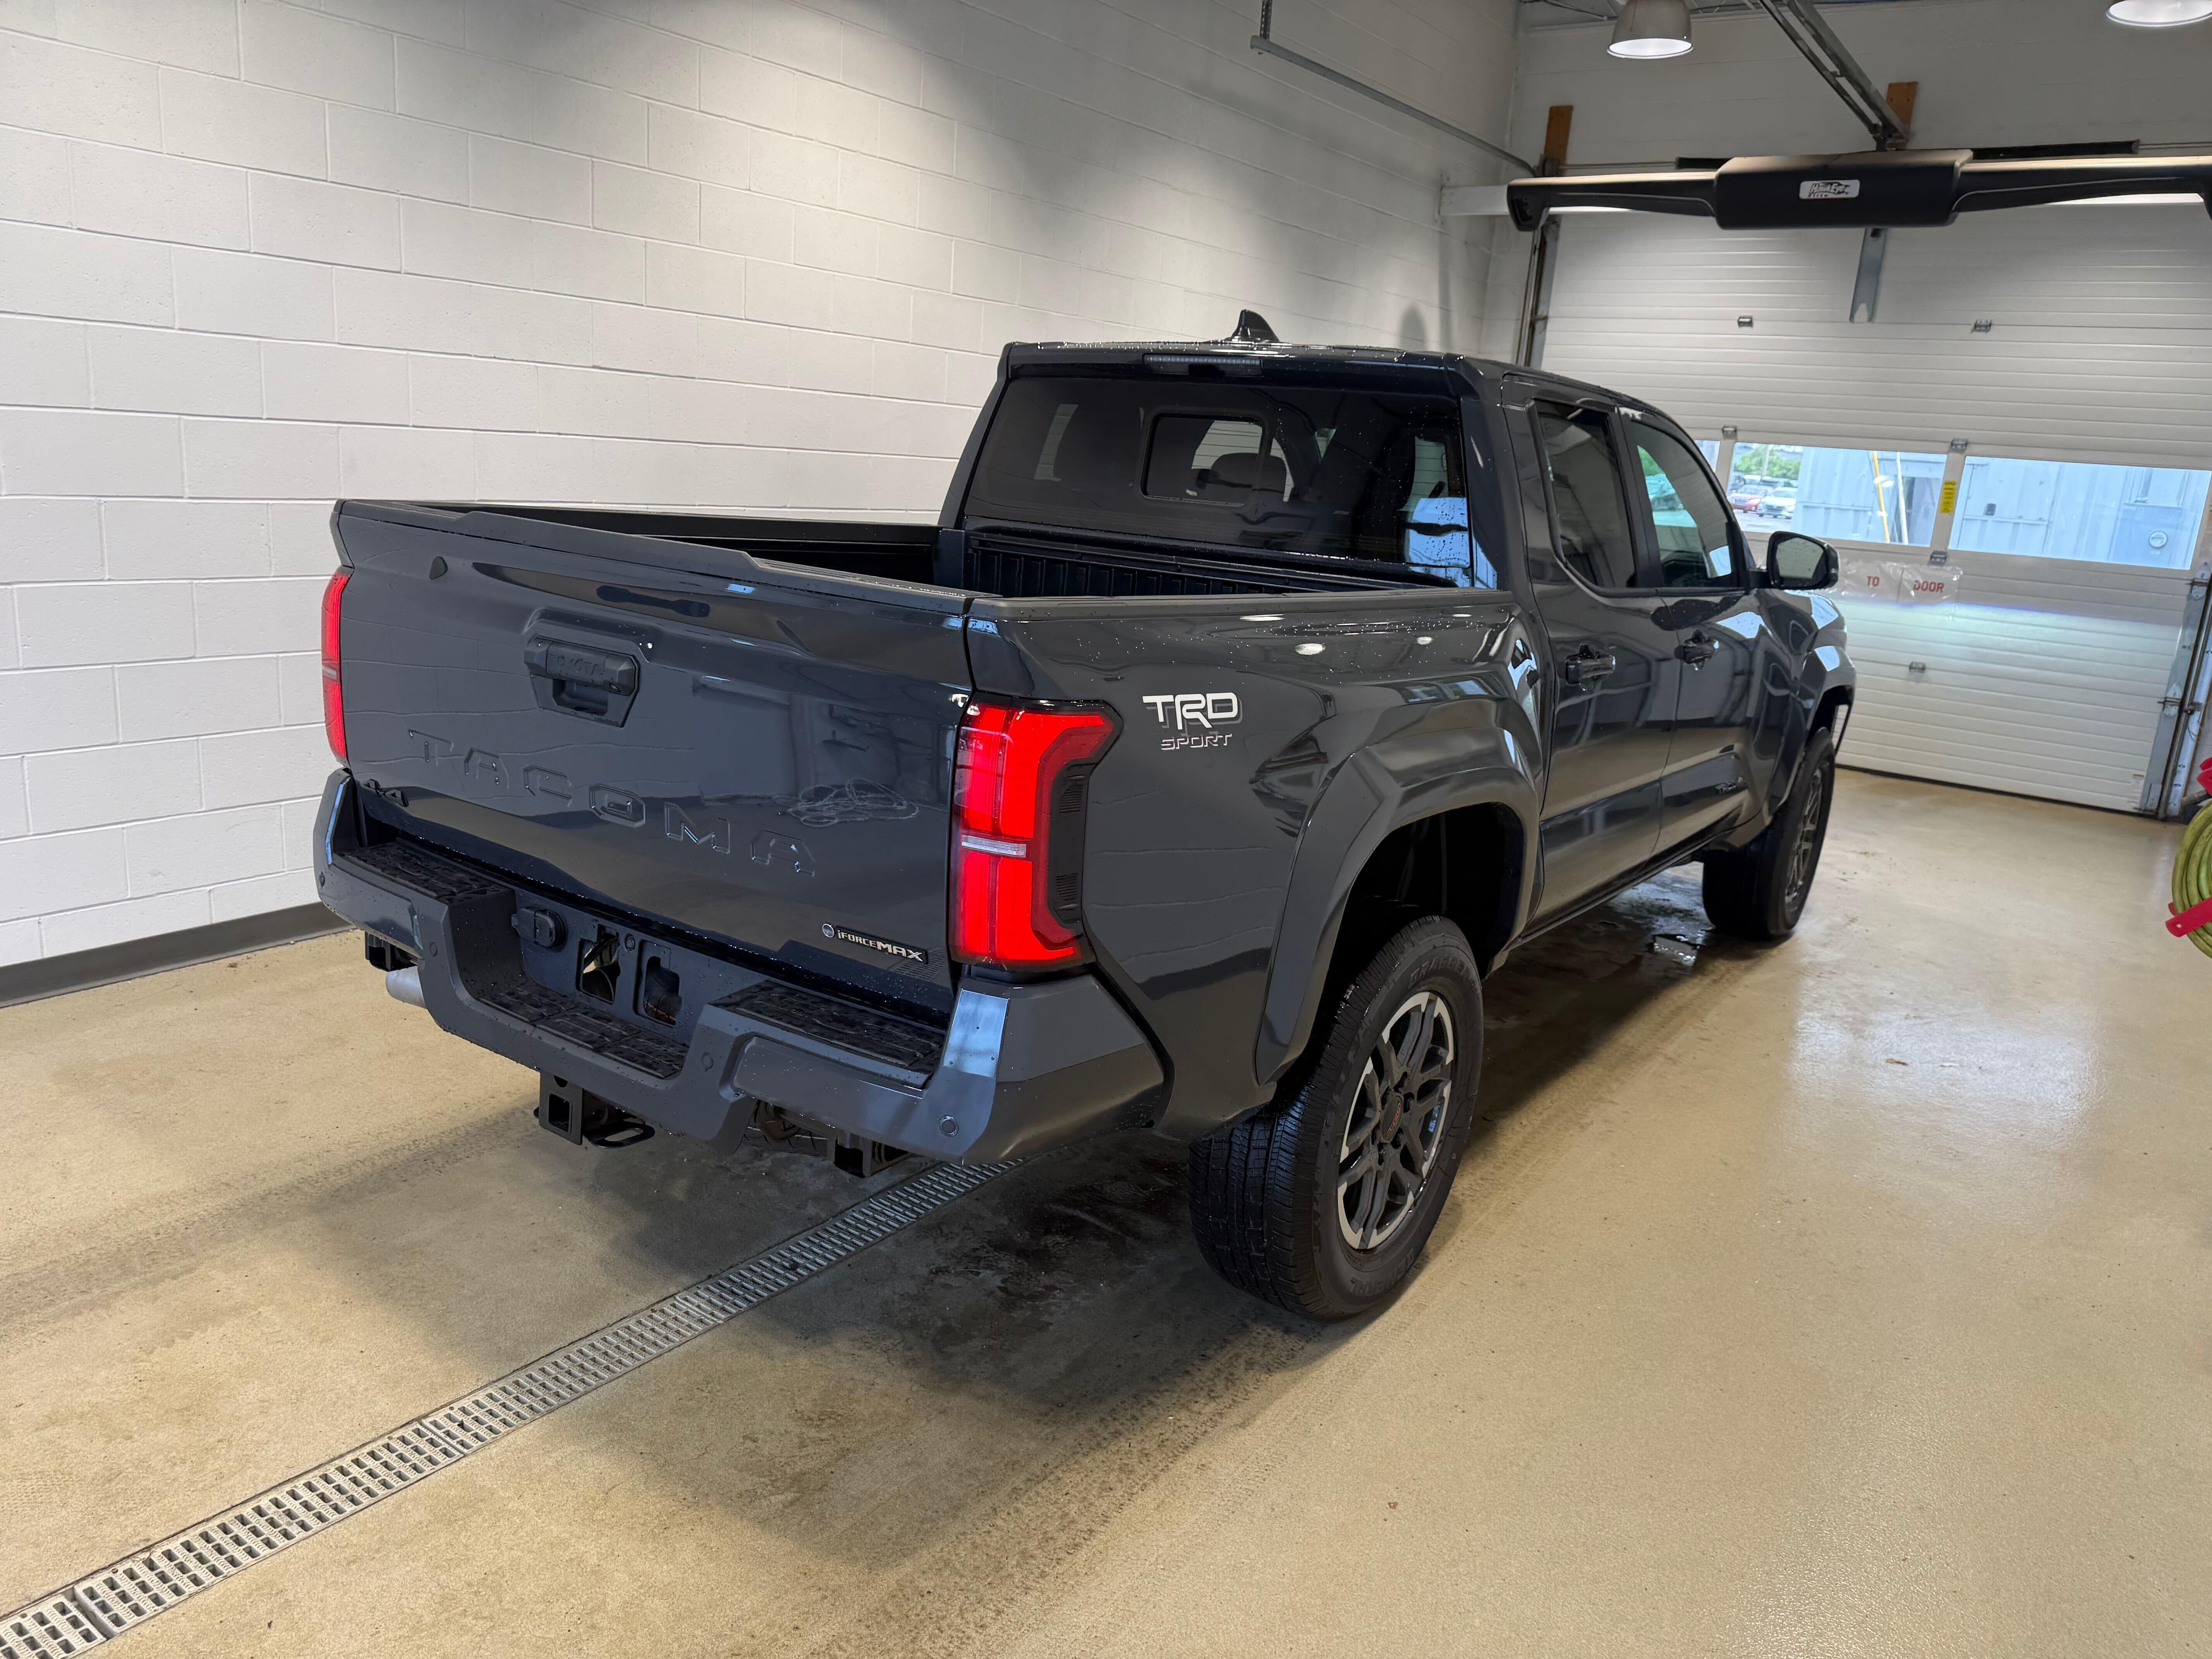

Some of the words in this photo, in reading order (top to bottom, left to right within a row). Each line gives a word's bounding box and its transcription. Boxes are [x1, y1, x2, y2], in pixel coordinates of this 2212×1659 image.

[1867, 576, 1880, 587] TO
[1913, 580, 1945, 593] DOOR
[1142, 692, 1238, 730] TRD
[1161, 733, 1233, 750] SPORT
[408, 728, 816, 877] TACOMA
